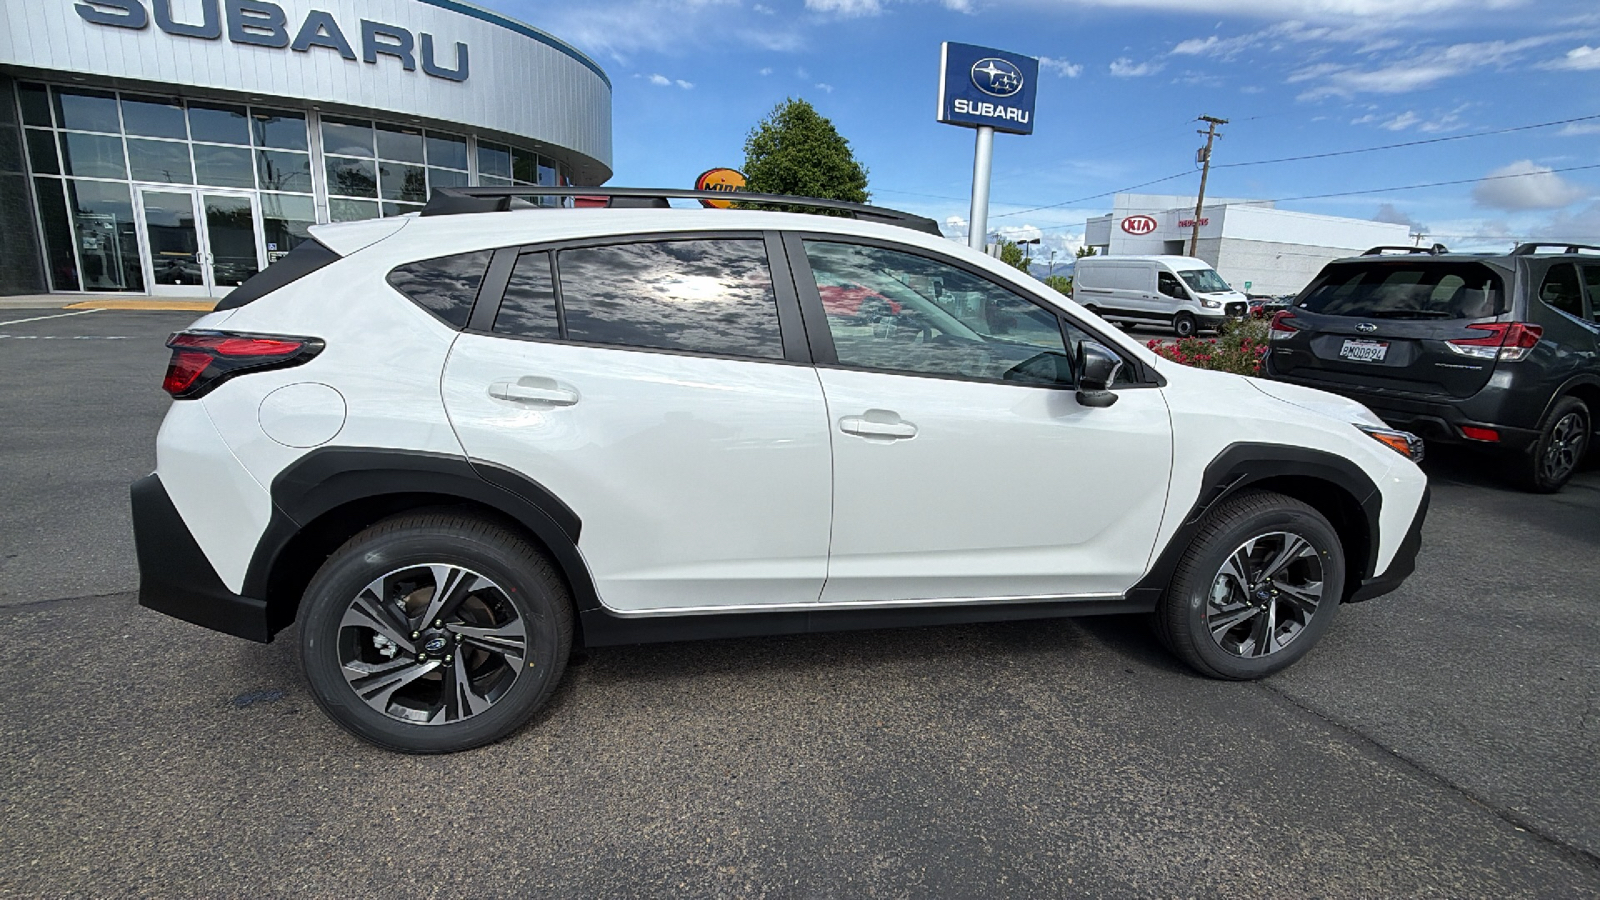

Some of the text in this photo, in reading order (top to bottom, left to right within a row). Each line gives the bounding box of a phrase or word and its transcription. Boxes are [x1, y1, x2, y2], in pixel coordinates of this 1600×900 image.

[74, 0, 469, 82] SUBARU
[954, 99, 1029, 124] SUBARU
[1128, 219, 1151, 231] KIA
